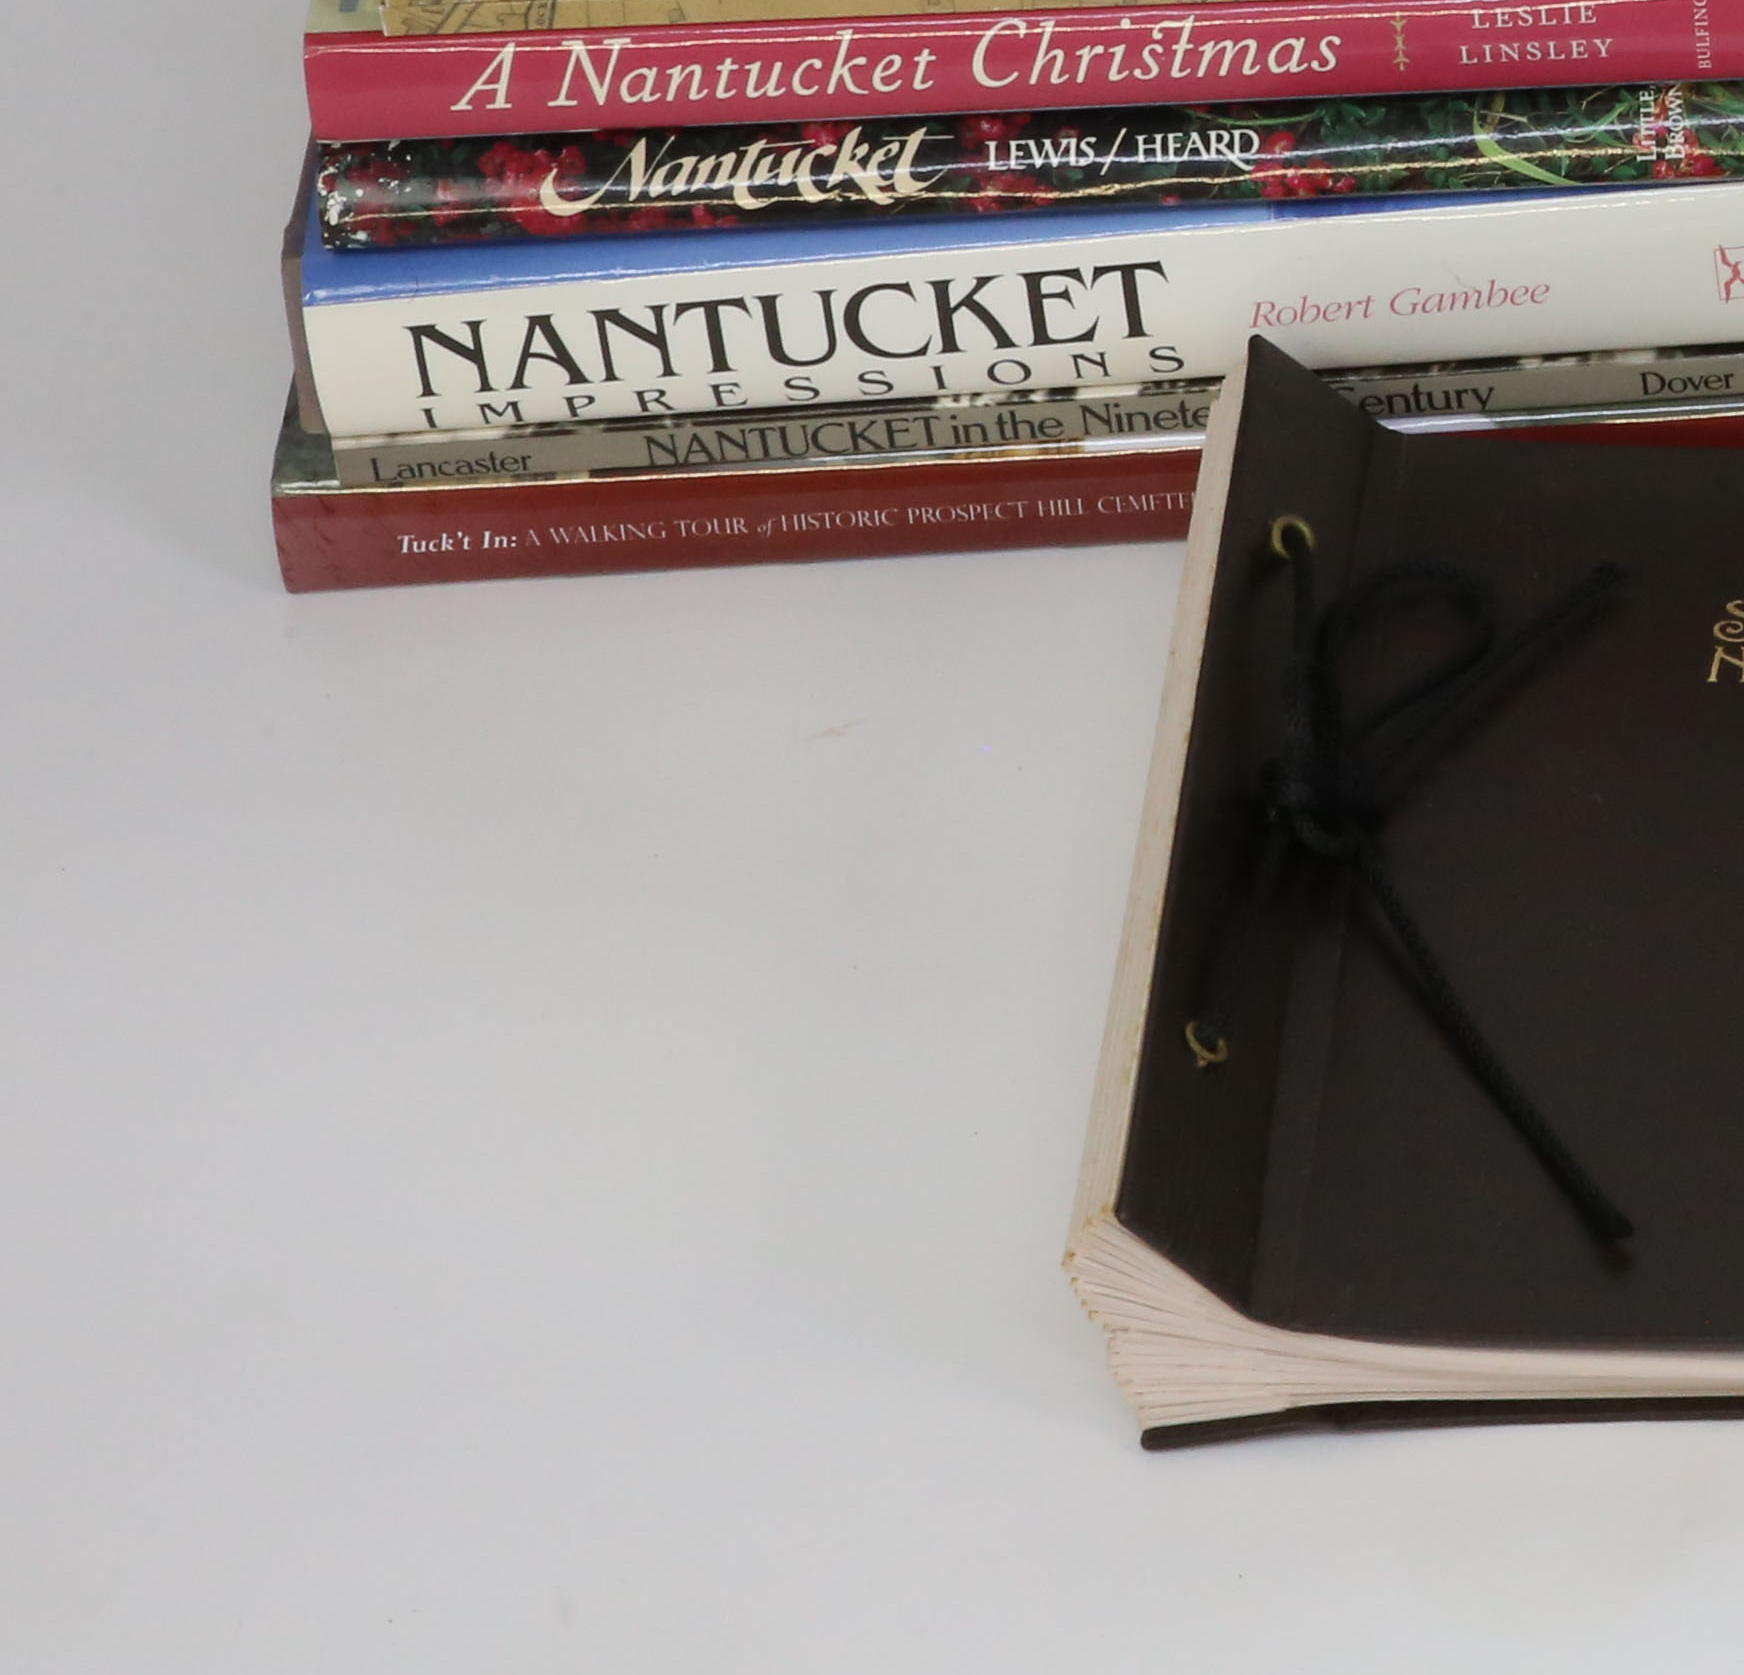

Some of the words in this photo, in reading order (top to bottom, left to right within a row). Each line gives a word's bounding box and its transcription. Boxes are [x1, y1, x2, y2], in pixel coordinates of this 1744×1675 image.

[451, 40, 518, 113] A
[547, 37, 939, 109] Nantucket
[971, 16, 1344, 91] Christmas
[1471, 1, 1599, 31] LESLIE
[1459, 36, 1616, 67] LINSLEY
[1636, 85, 1657, 162] LITTLE,
[1664, 81, 1687, 160] BROWN
[537, 125, 958, 219] Nantucket
[405, 257, 1170, 400] NANTUCKET
[1249, 291, 1376, 332] Robert
[1390, 278, 1551, 320] Gambee
[370, 449, 533, 484] Lancaster
[643, 414, 940, 468] NANTUCKET
[997, 409, 1065, 443] the
[1640, 367, 1736, 397] Dover
[420, 343, 1186, 431] IMPRESSIONS
[396, 531, 473, 554] Tuck't
[482, 529, 518, 550] In:
[549, 520, 667, 545] WALKING
[673, 516, 749, 538] TOUR
[780, 507, 899, 533] HISTORIC
[907, 500, 1029, 525] PROSPECT
[1037, 497, 1087, 518] HILL
